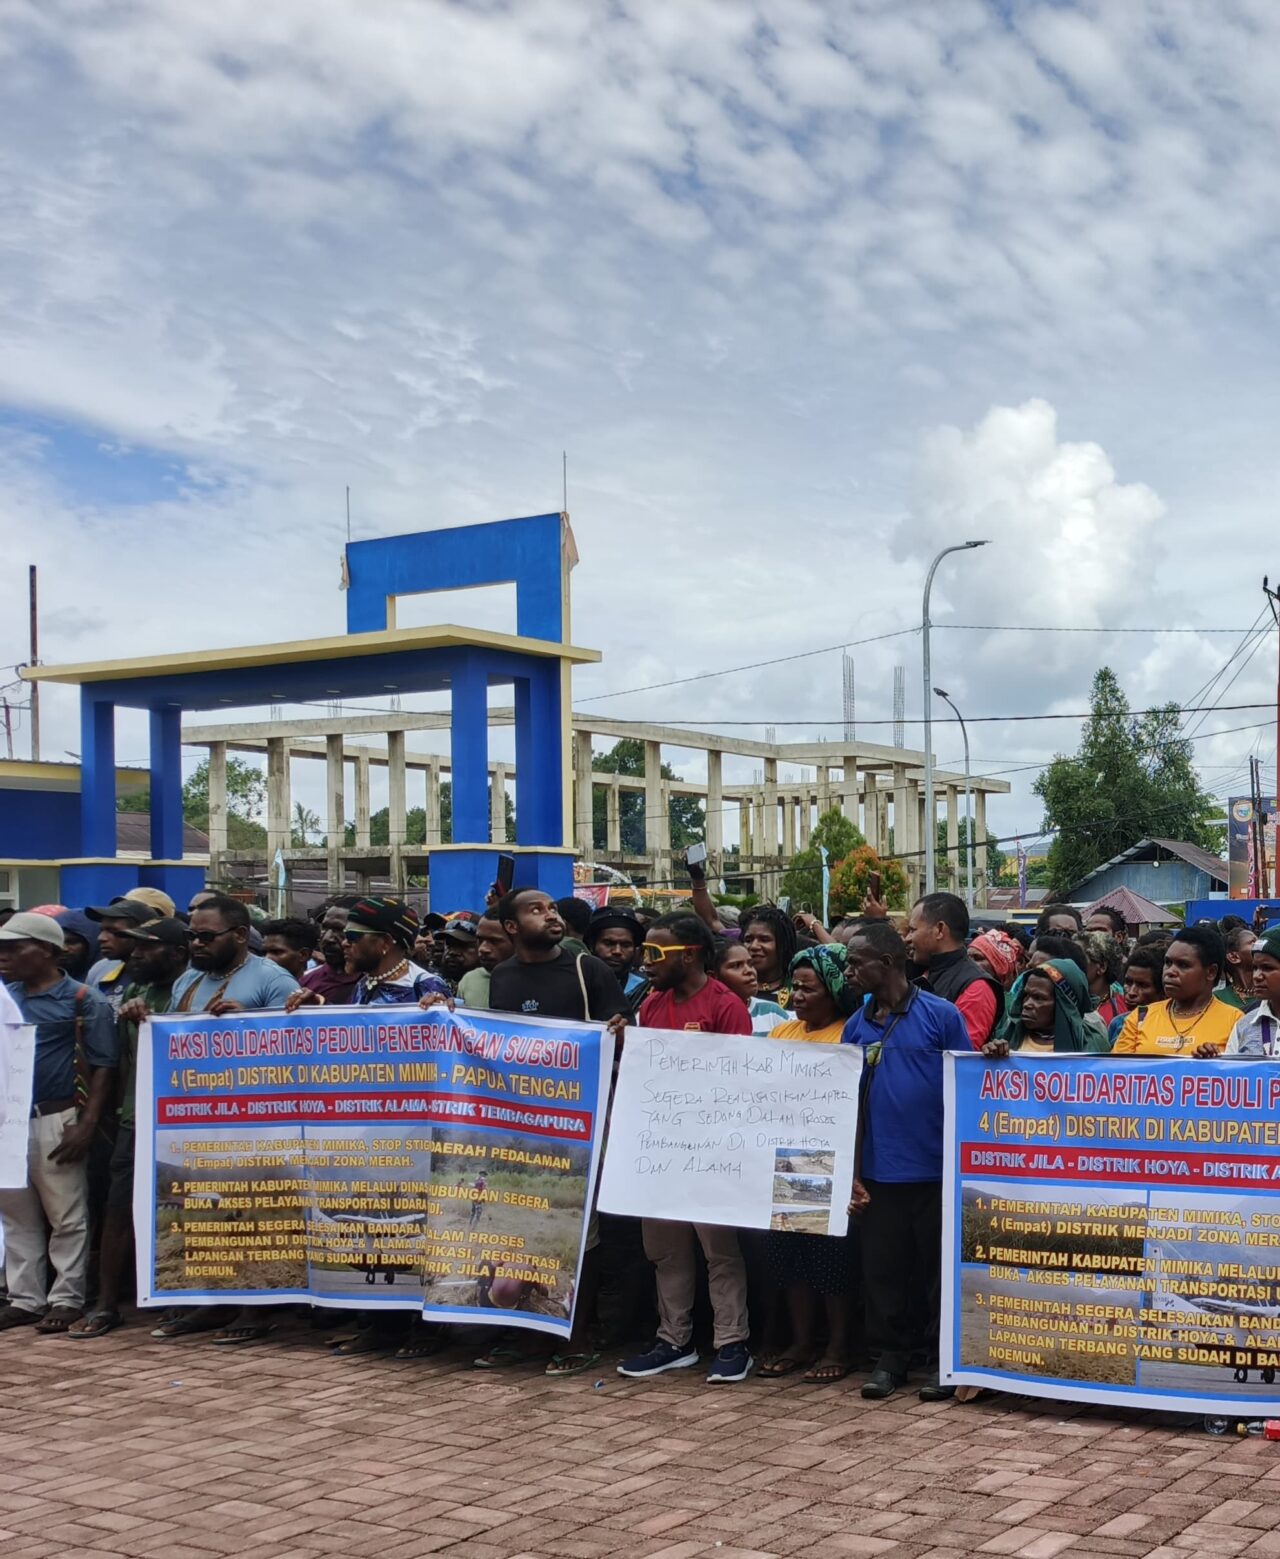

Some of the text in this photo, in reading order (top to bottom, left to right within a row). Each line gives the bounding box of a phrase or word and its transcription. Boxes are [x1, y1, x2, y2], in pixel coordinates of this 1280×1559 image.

[169, 1032, 209, 1060] AKSI
[211, 1026, 313, 1058] SOLIDARITAS
[318, 1025, 374, 1054] PEDULI
[503, 1035, 580, 1070] SUBSIDI
[171, 1070, 179, 1087] 4
[182, 1067, 234, 1091] (Empat)
[238, 1065, 295, 1085] DISTRIK
[298, 1065, 308, 1083] DI
[311, 1063, 395, 1084] KABUPATEN
[452, 1064, 506, 1091] PAPUA
[509, 1074, 580, 1100] TENGAH
[742, 1054, 773, 1077] KAB
[980, 1069, 1028, 1100] AKSI
[1034, 1071, 1175, 1106] SOLIDARITAS
[1180, 1075, 1262, 1109] PEDULI
[166, 1102, 212, 1117] DISTRIK
[215, 1101, 239, 1115] JILA
[247, 1100, 297, 1114] DISTRIK
[300, 1100, 326, 1113] HOYA
[335, 1099, 382, 1113] DISTRIK
[385, 1099, 428, 1112] ALAMA
[479, 1104, 586, 1132] TEMBAGAPURA
[641, 1110, 684, 1128] YANG
[979, 1112, 989, 1132] 4
[993, 1112, 1060, 1140] (Empat)
[1065, 1115, 1140, 1140] DISTRIK
[1145, 1118, 1164, 1140] DI
[682, 1155, 742, 1179] ALAMA
[971, 1151, 1026, 1168] DISTRIK
[1029, 1153, 1064, 1169] JILA
[1077, 1156, 1141, 1173] DISTRIK
[1147, 1159, 1190, 1175] HOYA
[1203, 1162, 1269, 1179] DISTRIK
[975, 1198, 987, 1210] 1.
[990, 1199, 1081, 1216] PEMERINTAH
[1086, 1204, 1178, 1222] KABUPATEN
[1183, 1209, 1246, 1228] MIMIKA,
[990, 1217, 998, 1229] 4
[1001, 1218, 1051, 1236] (Empat)
[1056, 1221, 1118, 1237] DISTRIK
[1123, 1225, 1193, 1242] MENJADI
[1197, 1229, 1240, 1244] ZONA
[185, 1251, 244, 1262] LAPANGAN
[247, 1250, 304, 1261] TERBANG
[307, 1251, 325, 1262] YANG
[327, 1253, 363, 1263] SUDAH
[366, 1254, 378, 1264] DI
[457, 1263, 490, 1277] JILA
[495, 1266, 557, 1286] BANDARA
[185, 1265, 237, 1277] NOEMUN.
[975, 1246, 986, 1259] 2.
[989, 1246, 1067, 1267] PEMERINTAH
[1072, 1253, 1156, 1273] KABUPATEN
[1160, 1259, 1214, 1276] MIMIKA
[1218, 1262, 1280, 1281] MELALUI
[989, 1266, 1020, 1282] BUKA
[1026, 1272, 1070, 1286] AKSES
[1074, 1275, 1157, 1293] PELAYANAN
[1161, 1279, 1271, 1300] TRANSPORTASI
[975, 1293, 986, 1306] 3.
[989, 1294, 1071, 1315] PEMERINTAH
[1075, 1304, 1134, 1320] SEGERA
[1139, 1310, 1234, 1327] SELESAIKAN
[989, 1312, 1089, 1334] PEMBANGUNAN
[1093, 1322, 1109, 1336] DI
[1113, 1324, 1172, 1341] DISTRIK
[1178, 1330, 1219, 1345] HOYA
[1224, 1333, 1235, 1346] &
[988, 1346, 1045, 1366] NOEMUN.
[989, 1329, 1056, 1349] LAPANGAN
[1059, 1337, 1127, 1356] TERBANG
[1132, 1343, 1173, 1361] YANG
[1177, 1348, 1231, 1365] SUDAH
[1235, 1352, 1252, 1366] DI
